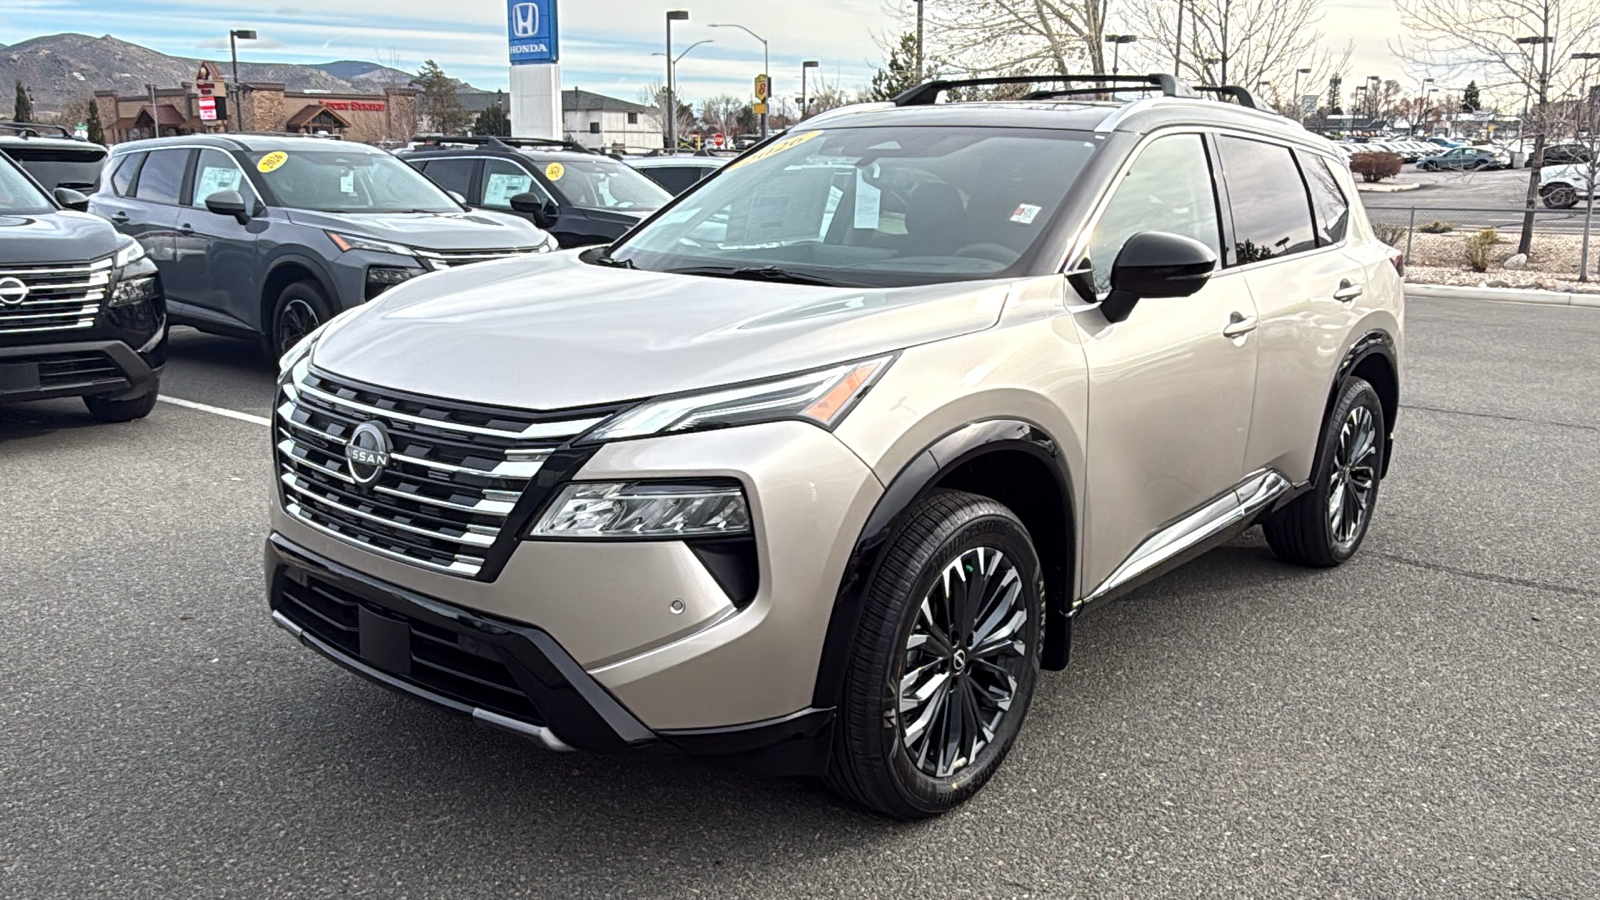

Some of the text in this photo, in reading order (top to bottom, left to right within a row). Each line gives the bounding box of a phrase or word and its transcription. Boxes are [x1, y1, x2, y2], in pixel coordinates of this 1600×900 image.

[510, 43, 548, 53] HONDA
[758, 82, 766, 95] 8
[1038, 580, 1047, 654] ALENZA
